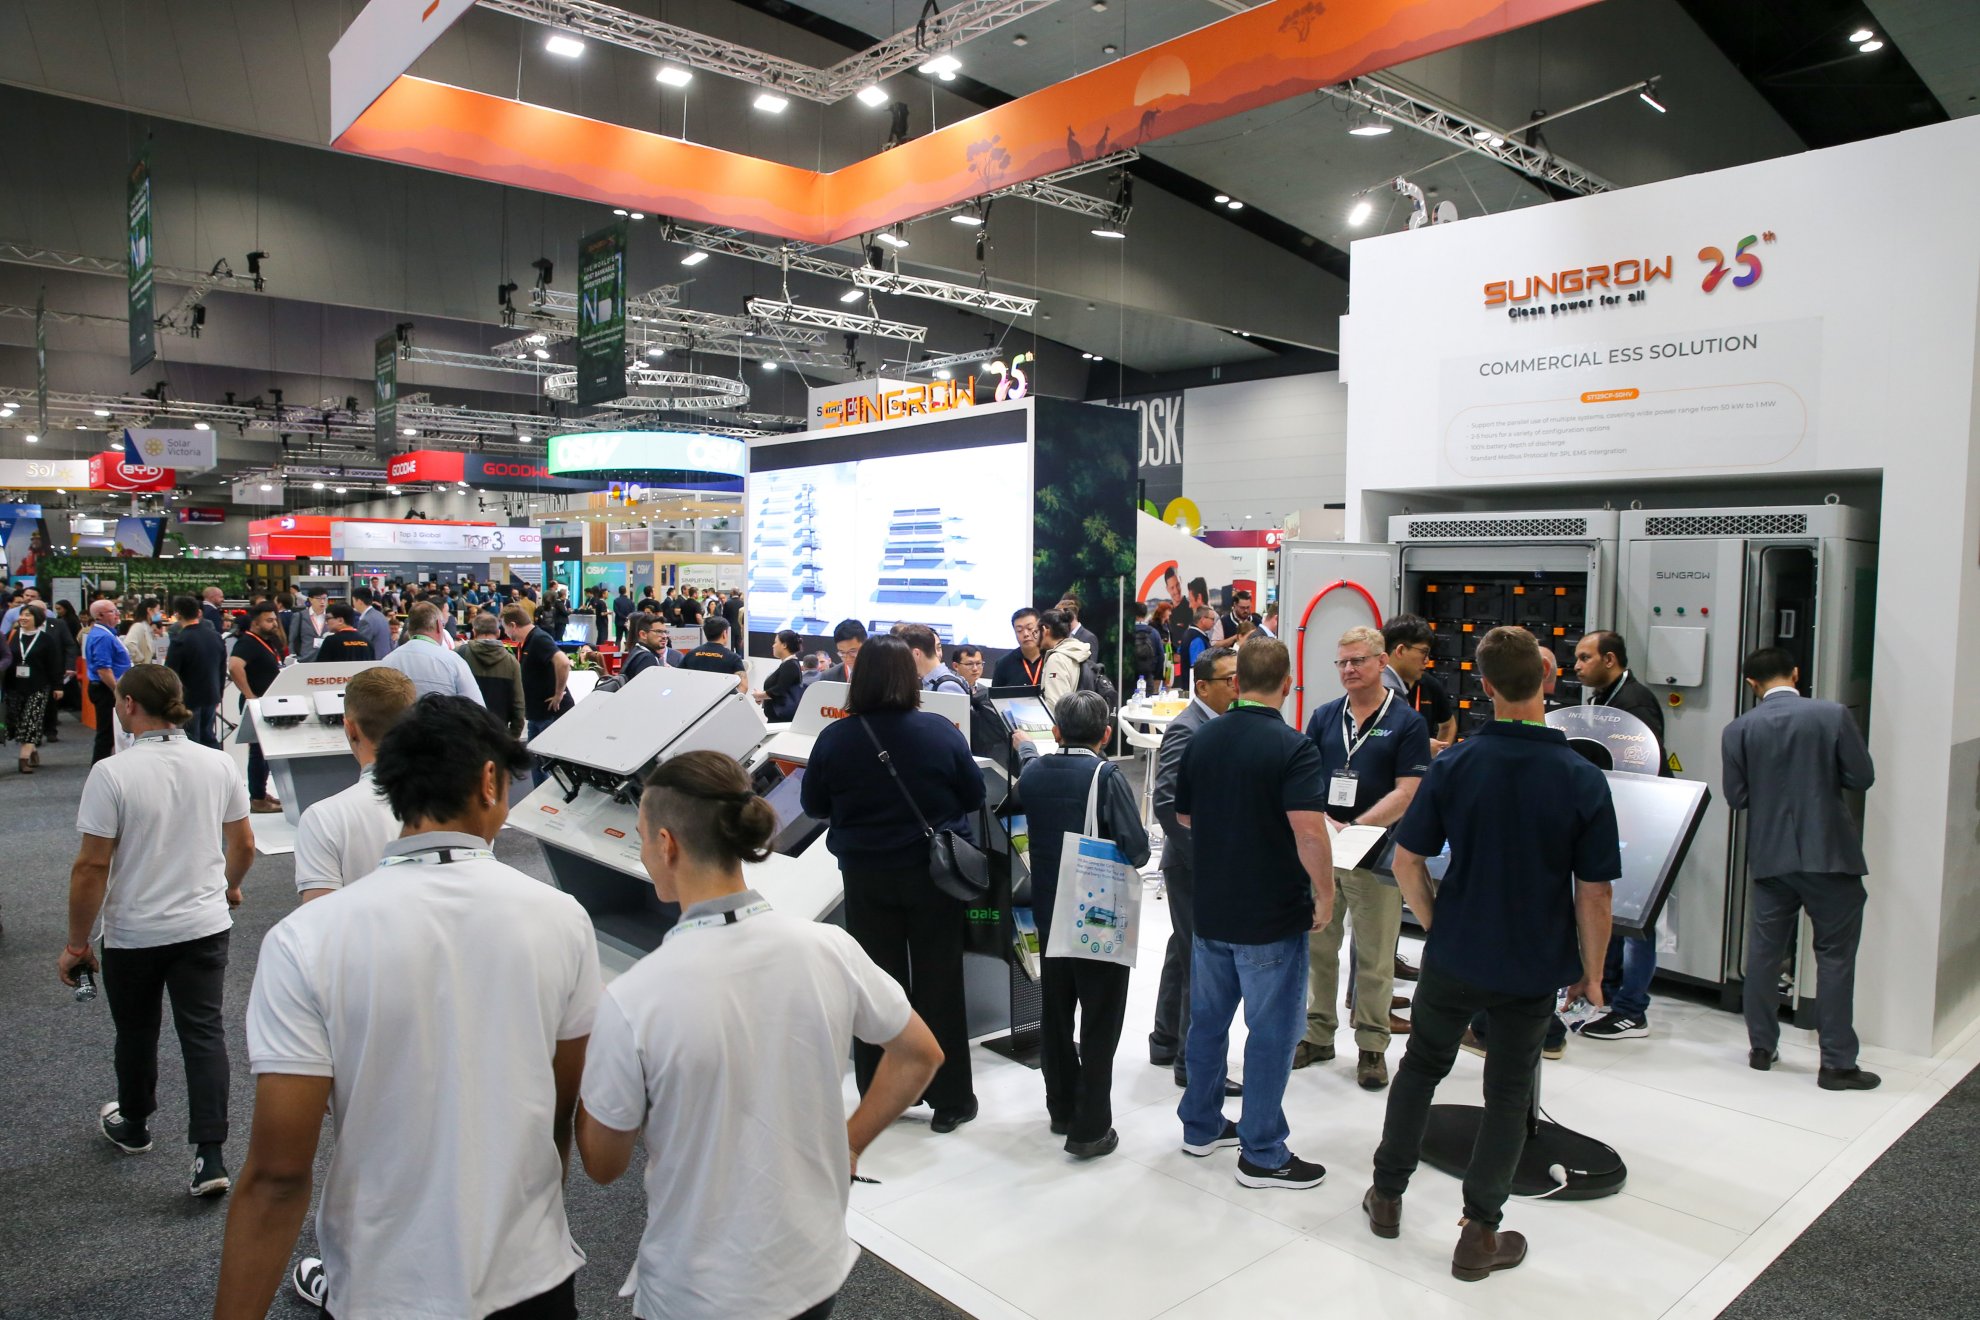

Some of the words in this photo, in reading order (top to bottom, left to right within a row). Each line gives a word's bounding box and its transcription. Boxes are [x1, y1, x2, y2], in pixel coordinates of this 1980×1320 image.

[1484, 256, 1672, 305] SUNGROW
[1508, 304, 1546, 319] Clean
[1550, 297, 1593, 315] power
[1599, 293, 1621, 306] for
[1628, 289, 1646, 303] all
[1479, 352, 1603, 377] COMMERCIAL
[1608, 346, 1643, 365] ESS
[1649, 334, 1758, 360] SOLUTION
[823, 375, 976, 430] SUNGROW
[1542, 416, 1550, 424] of
[1550, 415, 1576, 424] multiple
[1655, 408, 1677, 417] power
[1678, 406, 1699, 415] range
[1700, 404, 1718, 412] from
[1720, 403, 1730, 411] 50
[1731, 402, 1745, 410] kW
[1746, 401, 1754, 409] to
[1761, 400, 1777, 408] MW
[1481, 432, 1498, 440] hours
[1513, 429, 1533, 438] variety
[1542, 426, 1584, 436] configuration
[1585, 424, 1610, 433] options
[167, 438, 191, 447] Solar
[1486, 442, 1507, 451] battery
[1508, 441, 1527, 449] depth
[1535, 439, 1565, 448] discharge
[167, 447, 201, 456] Victoria
[1470, 454, 1497, 462] Standard
[1549, 450, 1558, 458] for
[123, 464, 159, 475] BYD
[391, 459, 417, 477] GOODWE
[586, 565, 608, 575] OSW
[1656, 571, 1711, 580] SUNGROW
